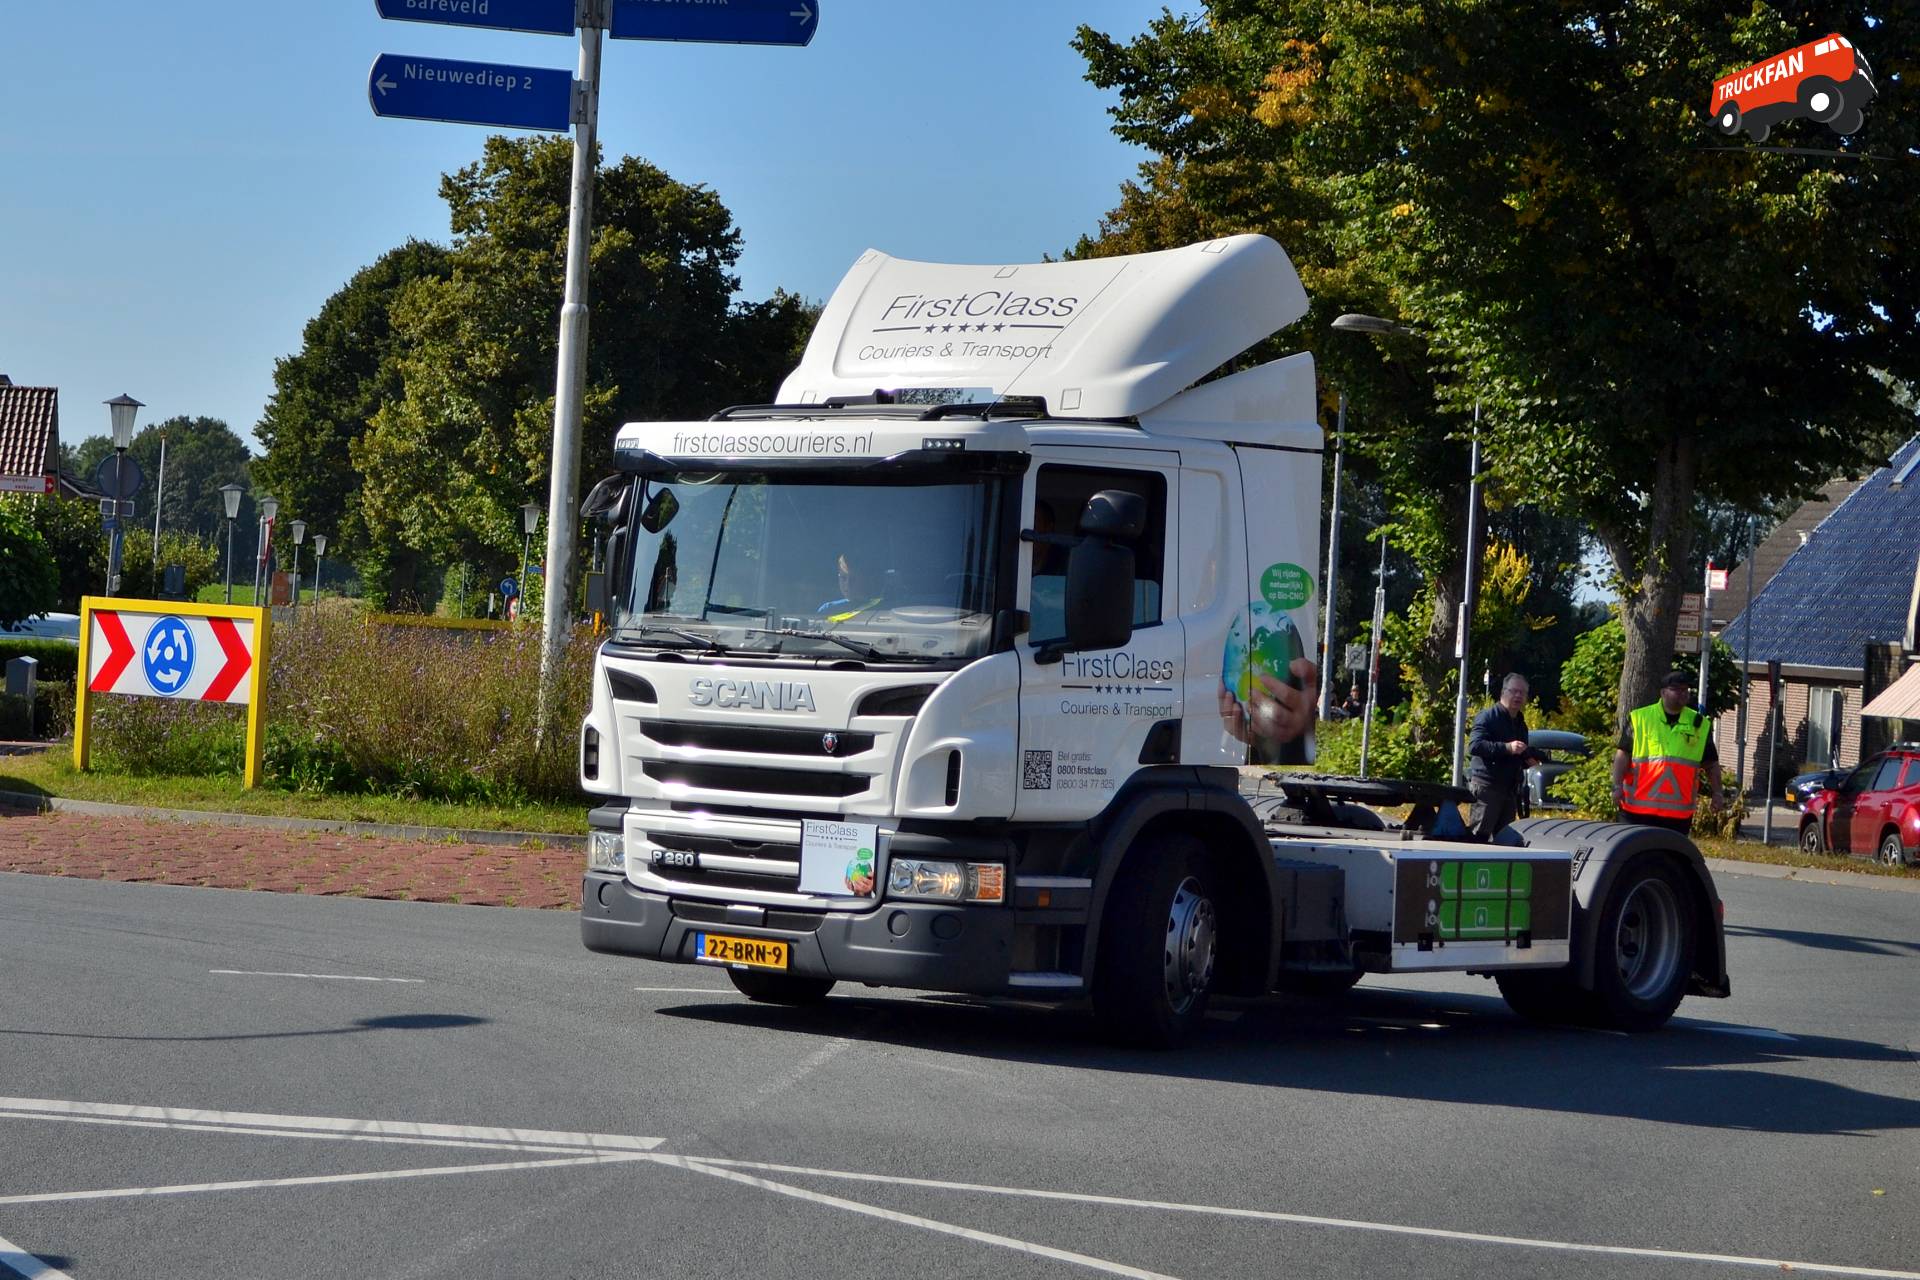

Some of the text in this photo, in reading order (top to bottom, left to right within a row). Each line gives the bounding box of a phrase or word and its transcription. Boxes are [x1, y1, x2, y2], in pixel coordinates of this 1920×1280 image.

[404, 63, 533, 92] Nieuwediep 2
[880, 291, 1078, 321] FirstClass
[858, 341, 1053, 361] Couriers & Transport
[673, 431, 874, 454] firstclasscouriers.nl
[1062, 651, 1174, 681] FirstClass
[688, 677, 816, 712] SCANIA
[1060, 700, 1173, 719] Couriers & Transport
[1057, 765, 1107, 776] 0800 firstclass
[806, 821, 858, 837] FirstClass
[652, 850, 694, 867] P 280
[709, 938, 782, 964] 22-BRN-9
